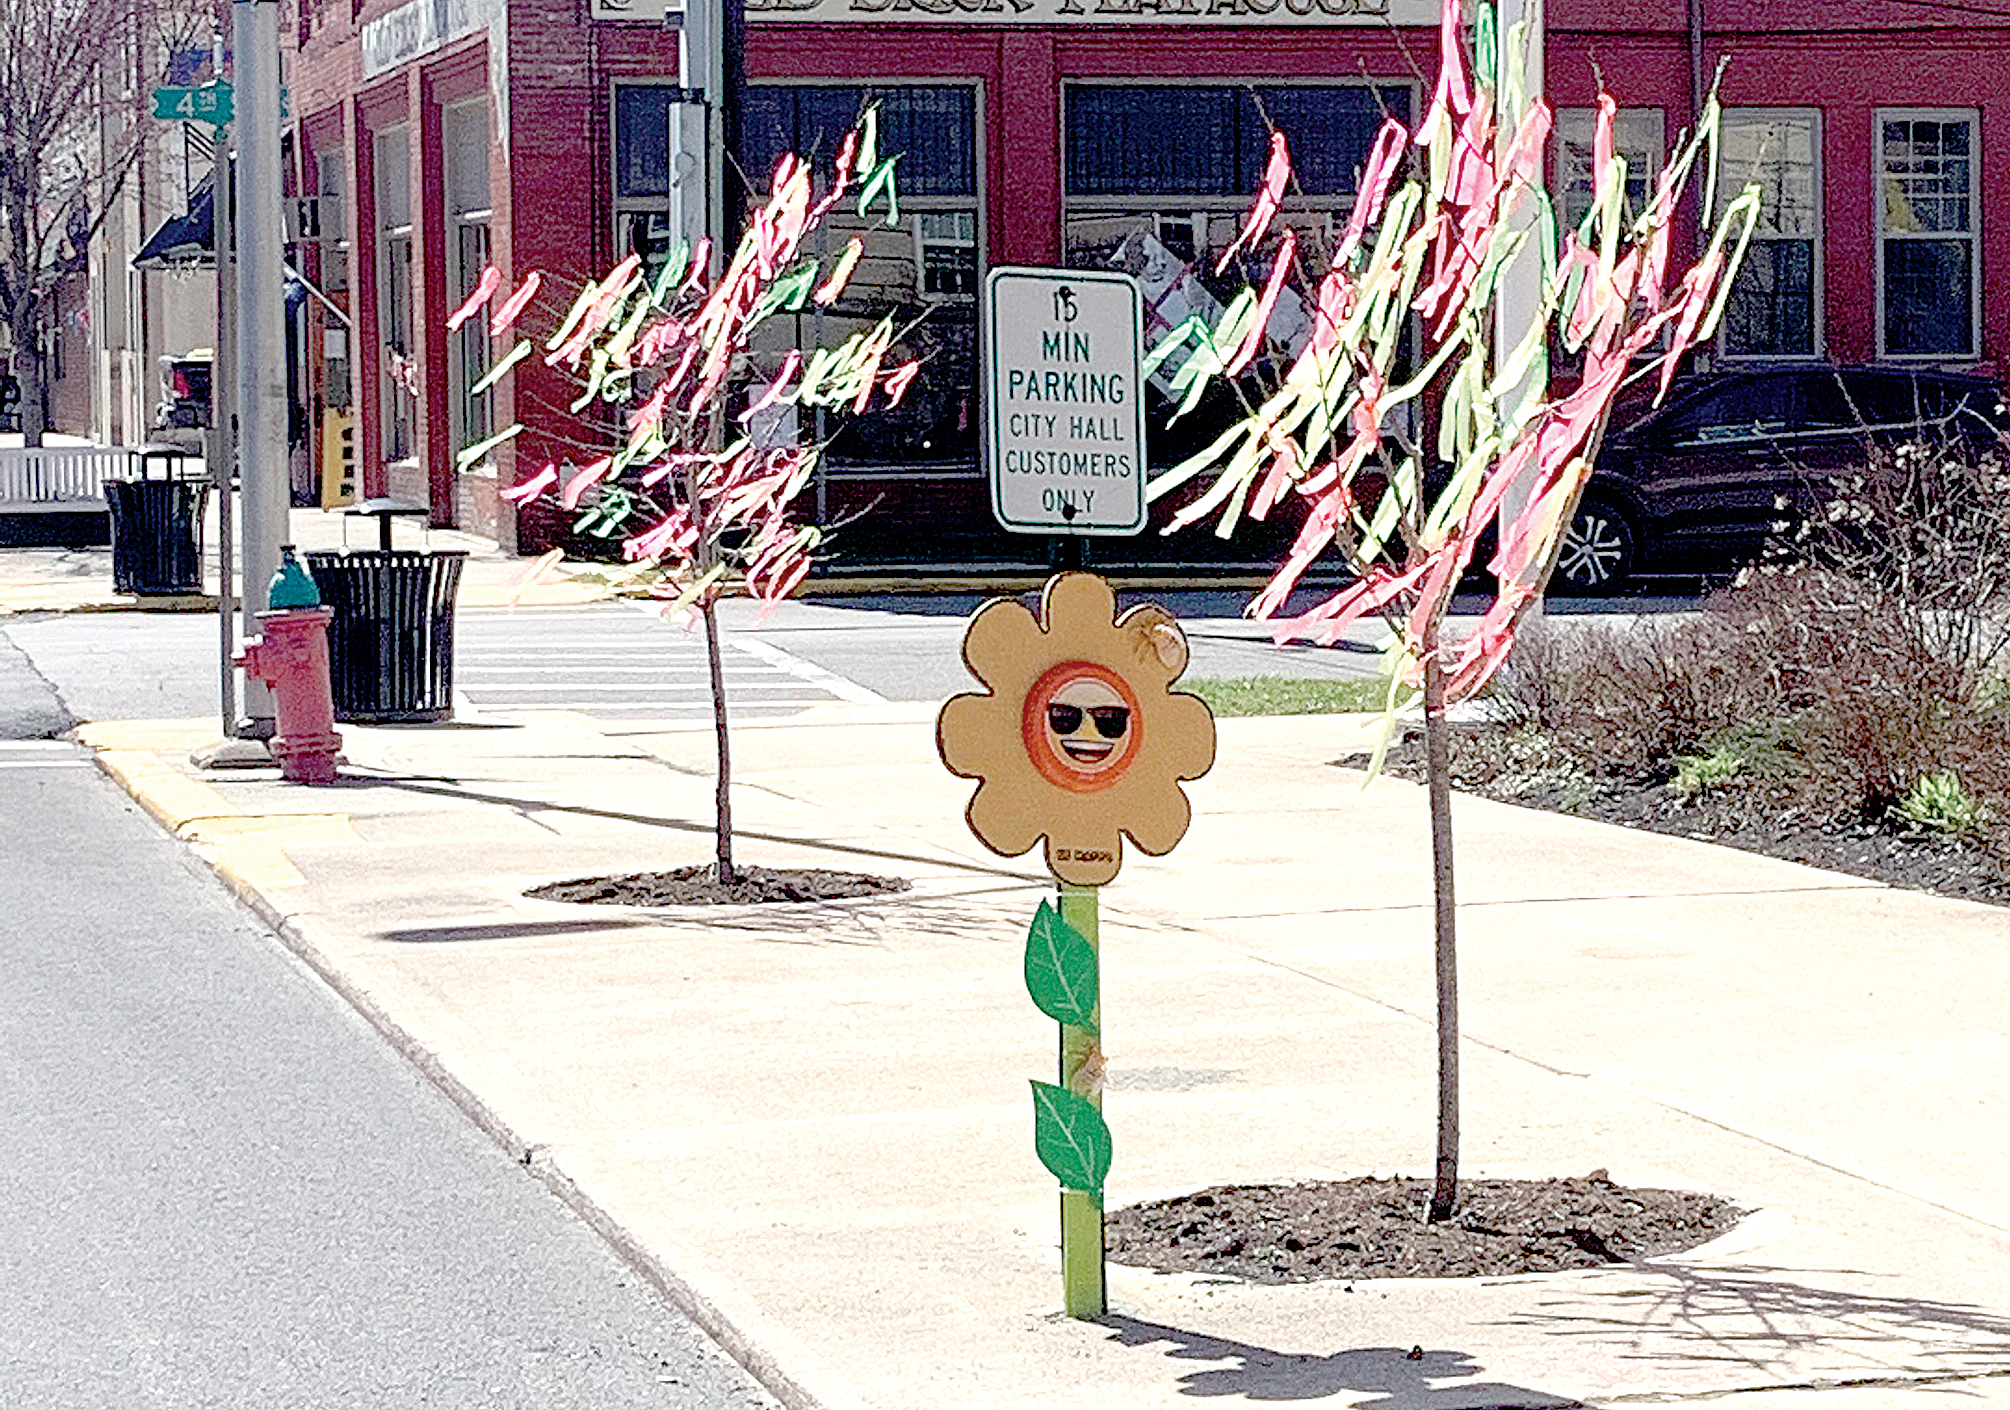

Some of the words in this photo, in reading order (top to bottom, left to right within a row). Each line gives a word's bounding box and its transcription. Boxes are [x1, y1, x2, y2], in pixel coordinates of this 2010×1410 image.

[1053, 290, 1078, 322] 15
[1042, 330, 1090, 363] MIN
[1008, 369, 1124, 405] PARKING
[1009, 413, 1057, 438] CITY
[1070, 415, 1125, 441] HALL
[1005, 449, 1130, 478] CUSTOMERS
[1041, 487, 1094, 513] ONLY
